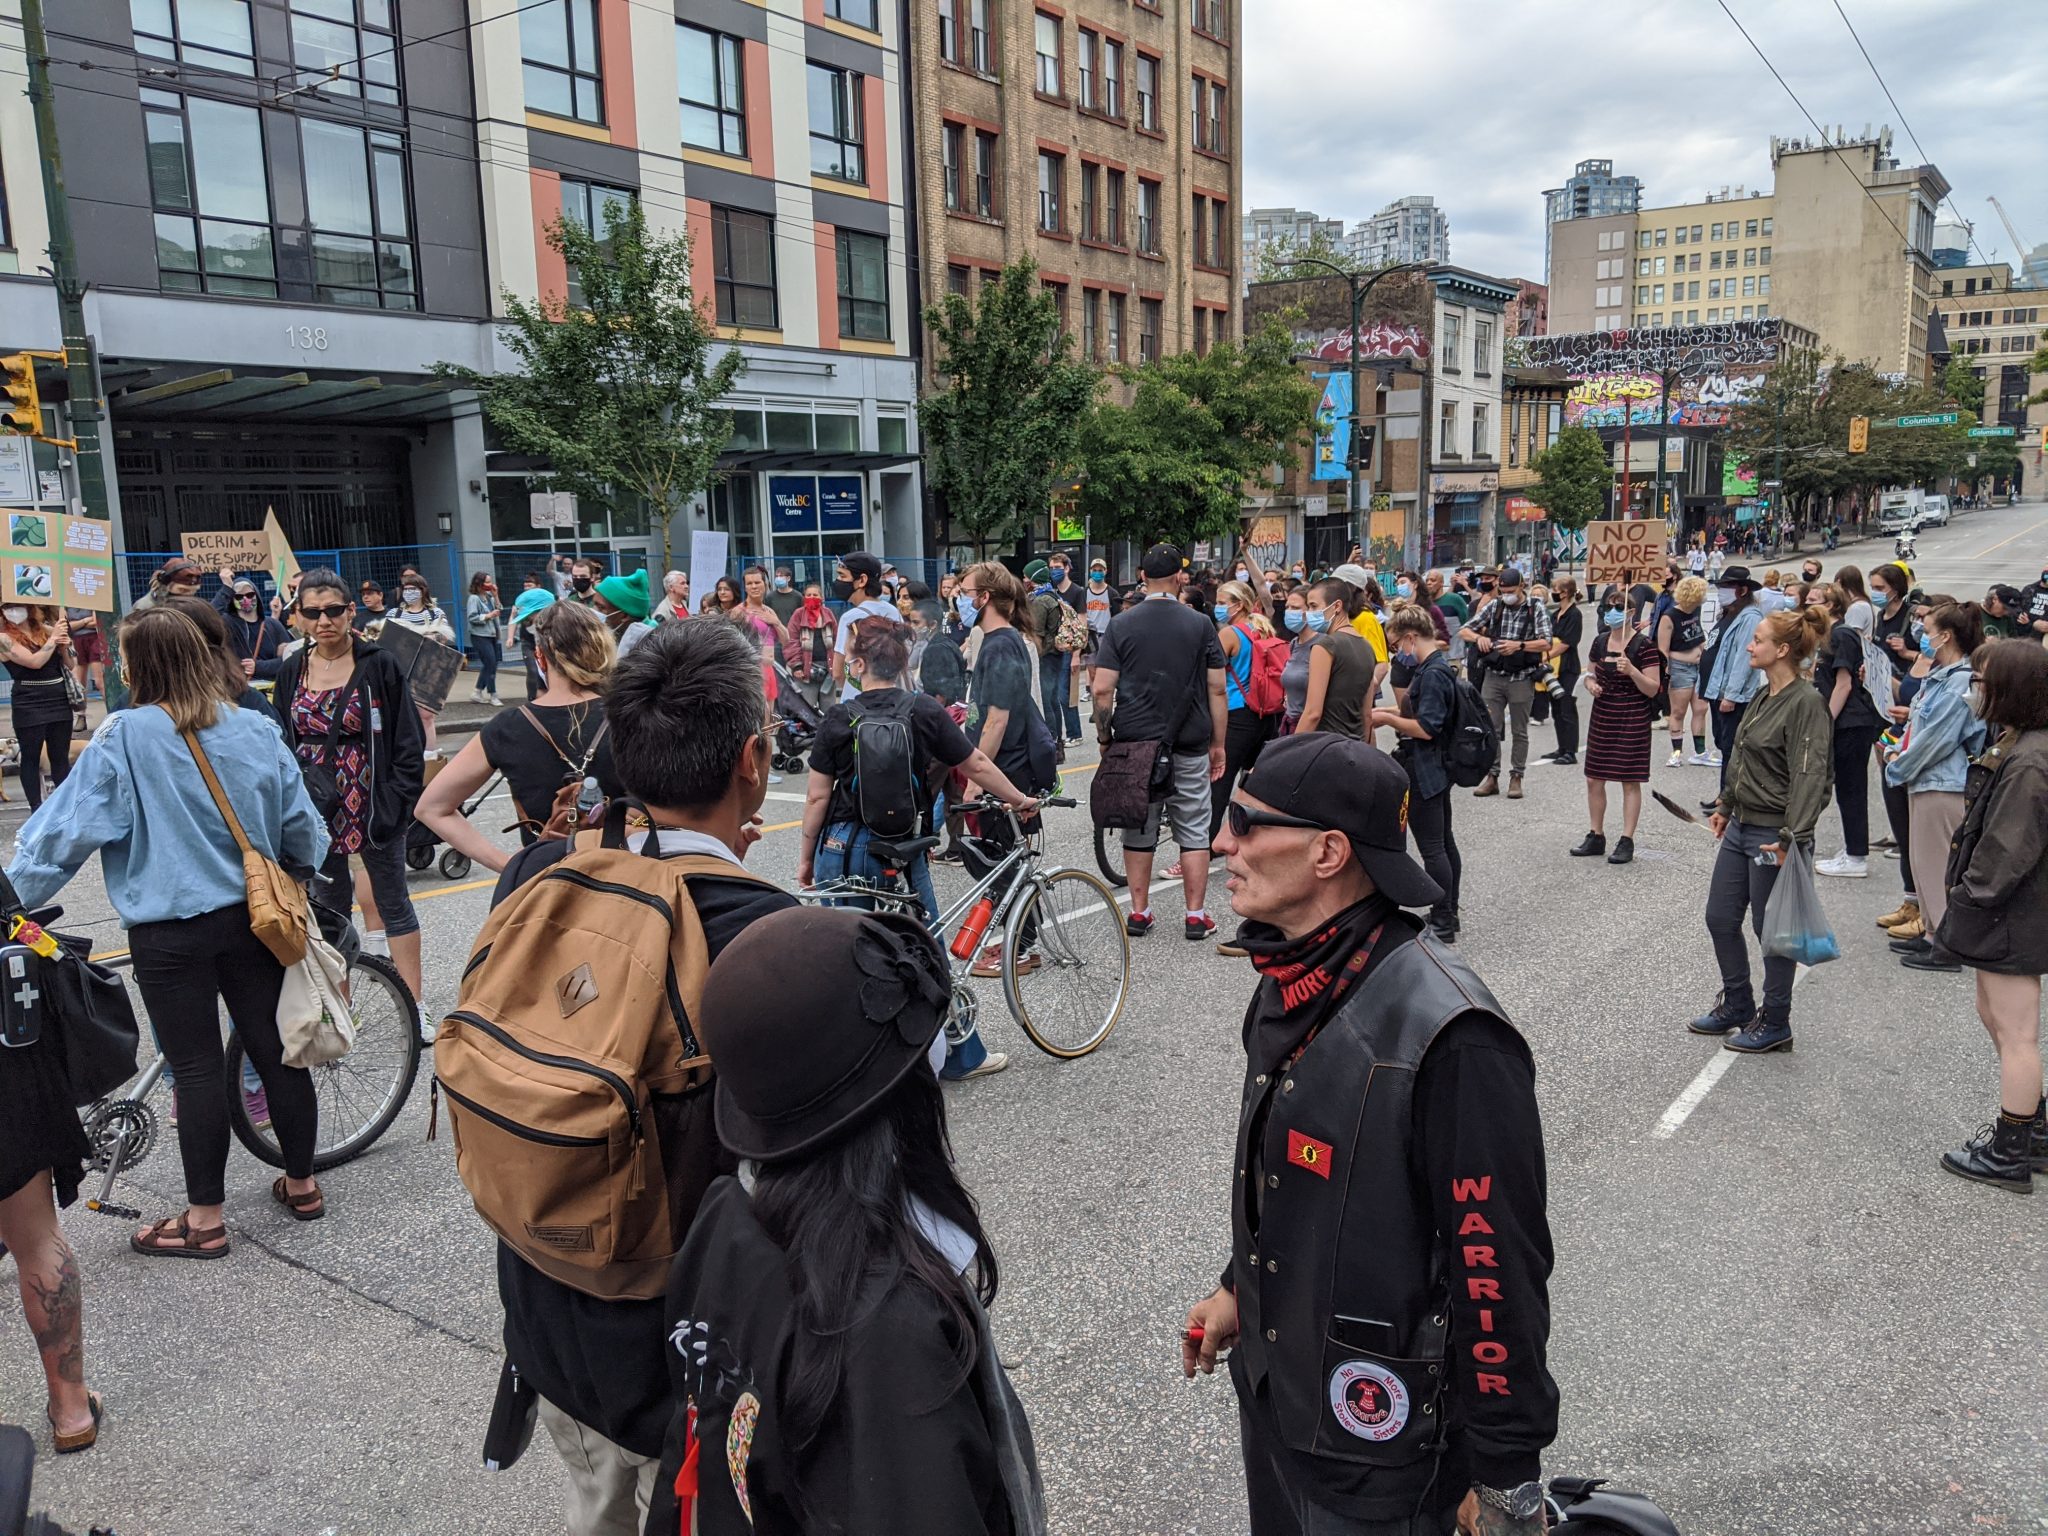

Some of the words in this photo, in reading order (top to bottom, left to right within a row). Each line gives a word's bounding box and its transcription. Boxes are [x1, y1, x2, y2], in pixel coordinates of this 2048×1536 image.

[286, 325, 328, 350] 138
[1903, 417, 1940, 425] Columbia
[776, 494, 810, 507] WorkBC
[785, 508, 802, 516] Centre
[187, 535, 244, 549] DECRIM
[1603, 523, 1647, 542] NO
[186, 553, 222, 566] SAFE
[223, 552, 268, 564] SUPPLY
[1588, 543, 1659, 565] MORE
[1590, 566, 1664, 583] DEATHS
[1280, 965, 1334, 1014] MORE
[1453, 1175, 1512, 1396] WARRIOR
[1340, 1368, 1354, 1379] No
[1384, 1376, 1403, 1400] More
[1334, 1403, 1356, 1432] Stolen
[1373, 1420, 1402, 1440] Sisters
